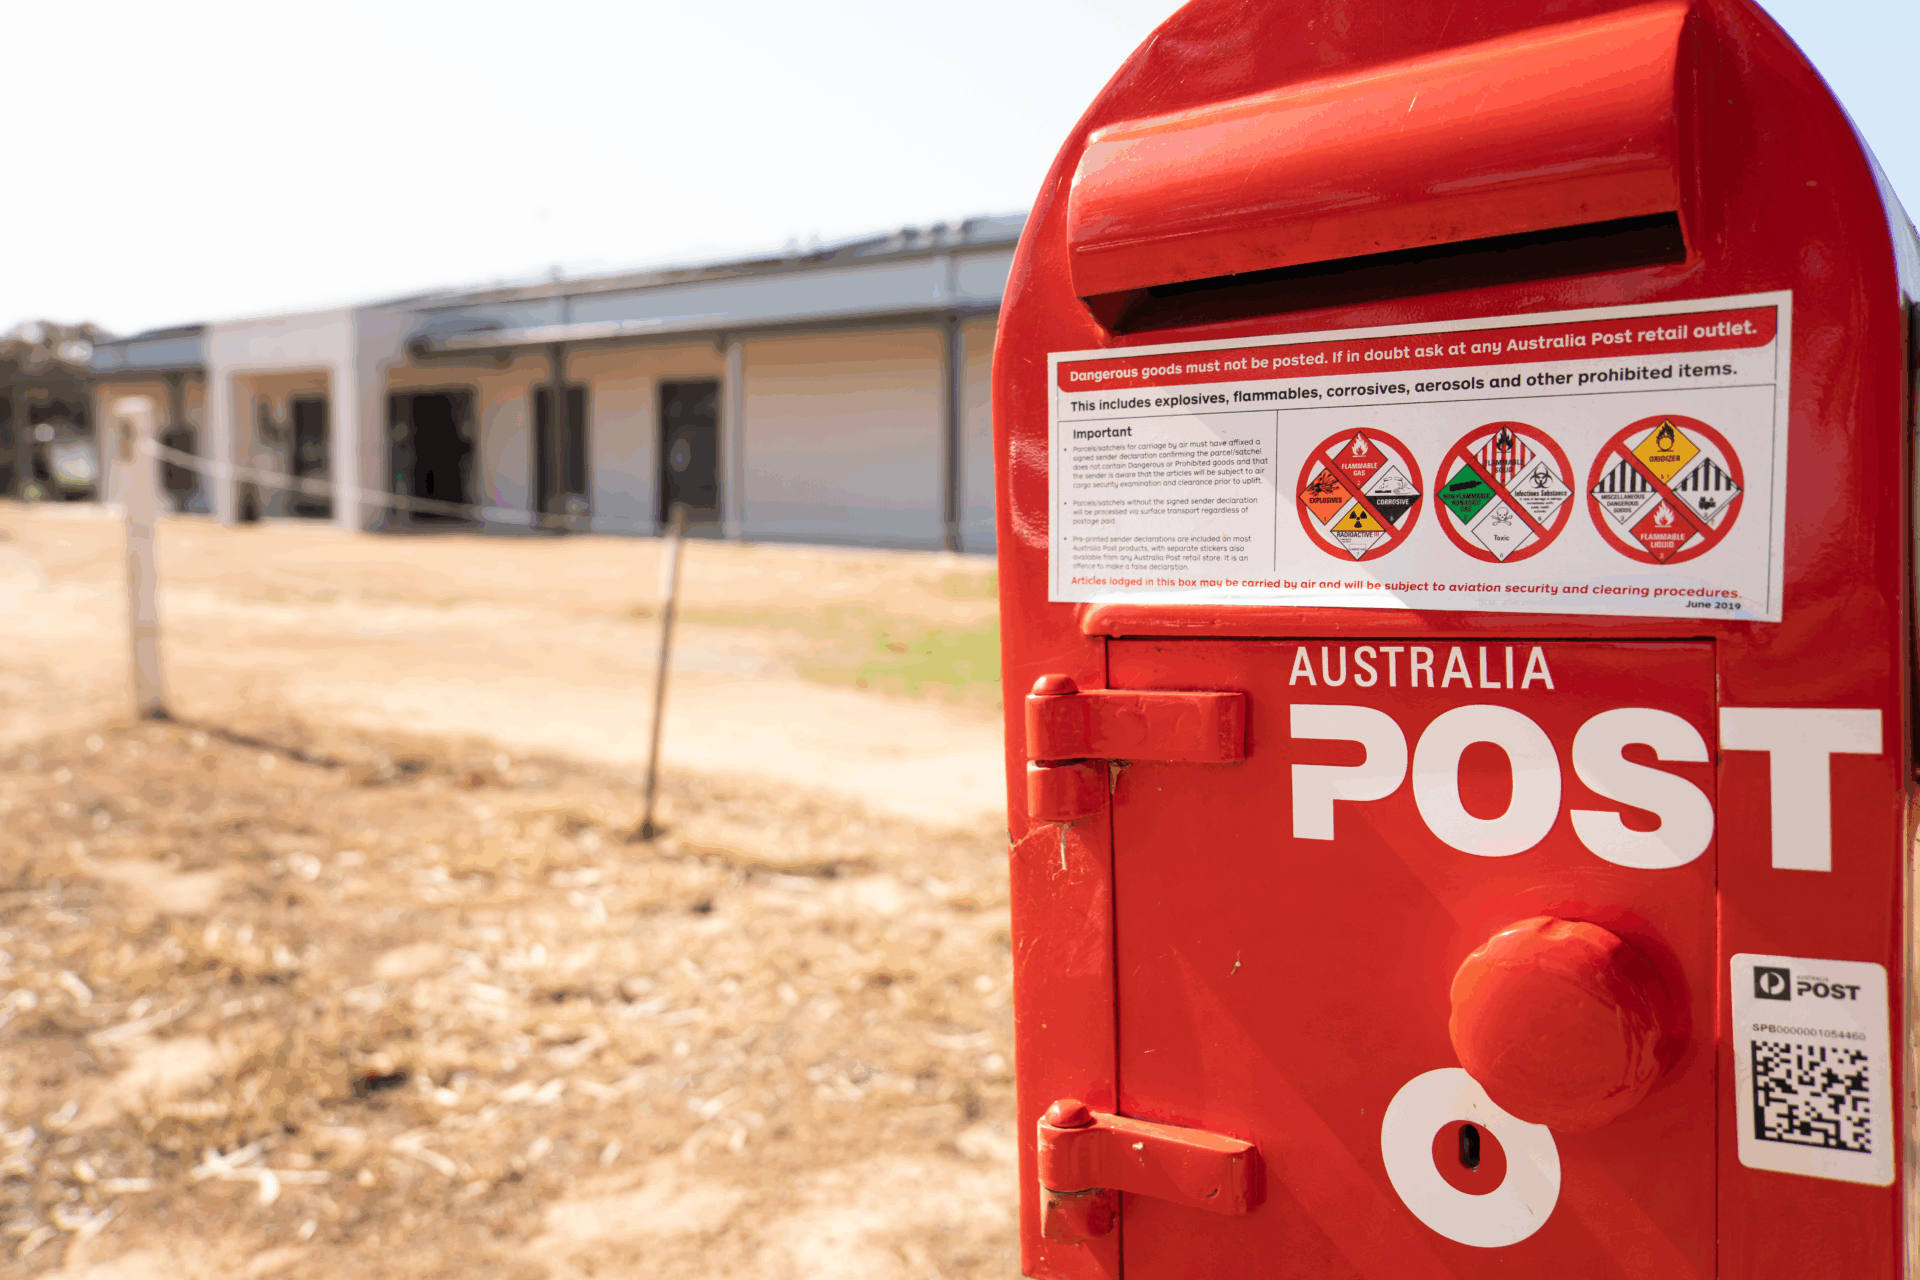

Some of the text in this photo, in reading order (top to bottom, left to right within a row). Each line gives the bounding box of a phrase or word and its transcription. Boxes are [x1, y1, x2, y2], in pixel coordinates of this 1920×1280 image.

[1070, 320, 1757, 382] Dangerous goods must not be posted. If in doubt ask at any Australia Post retail outlet.
[1070, 364, 1737, 411] This includes explosives, flammables, corrosives, aerosols and other prohibited items.
[1073, 426, 1132, 440] Important
[1212, 459, 1234, 467] goods
[1217, 468, 1243, 476] subject
[1166, 498, 1188, 506] signed
[1201, 507, 1239, 515] regardless
[1641, 533, 1685, 541] FLAMMABLE
[1071, 576, 1107, 585] Articles
[1109, 577, 1142, 587] lodged
[1156, 578, 1175, 586] this
[1178, 578, 1196, 586] box
[1225, 578, 1239, 586] be
[1241, 579, 1281, 588] carried
[1283, 579, 1298, 589] by
[1300, 579, 1316, 588] air
[1318, 580, 1341, 588] and
[1344, 580, 1363, 589] will
[1366, 580, 1381, 589] be
[1384, 581, 1429, 592] subject
[1432, 582, 1446, 591] to
[1448, 582, 1501, 592] aviation
[1504, 584, 1558, 595] security
[1562, 584, 1588, 594] and
[1592, 585, 1650, 597] clearing
[1653, 588, 1742, 598] procedures.
[1685, 600, 1741, 610] June 2019
[1289, 646, 1555, 690] AUSTRALIA
[1289, 703, 1883, 872] POST
[1797, 981, 1861, 1000] POST
